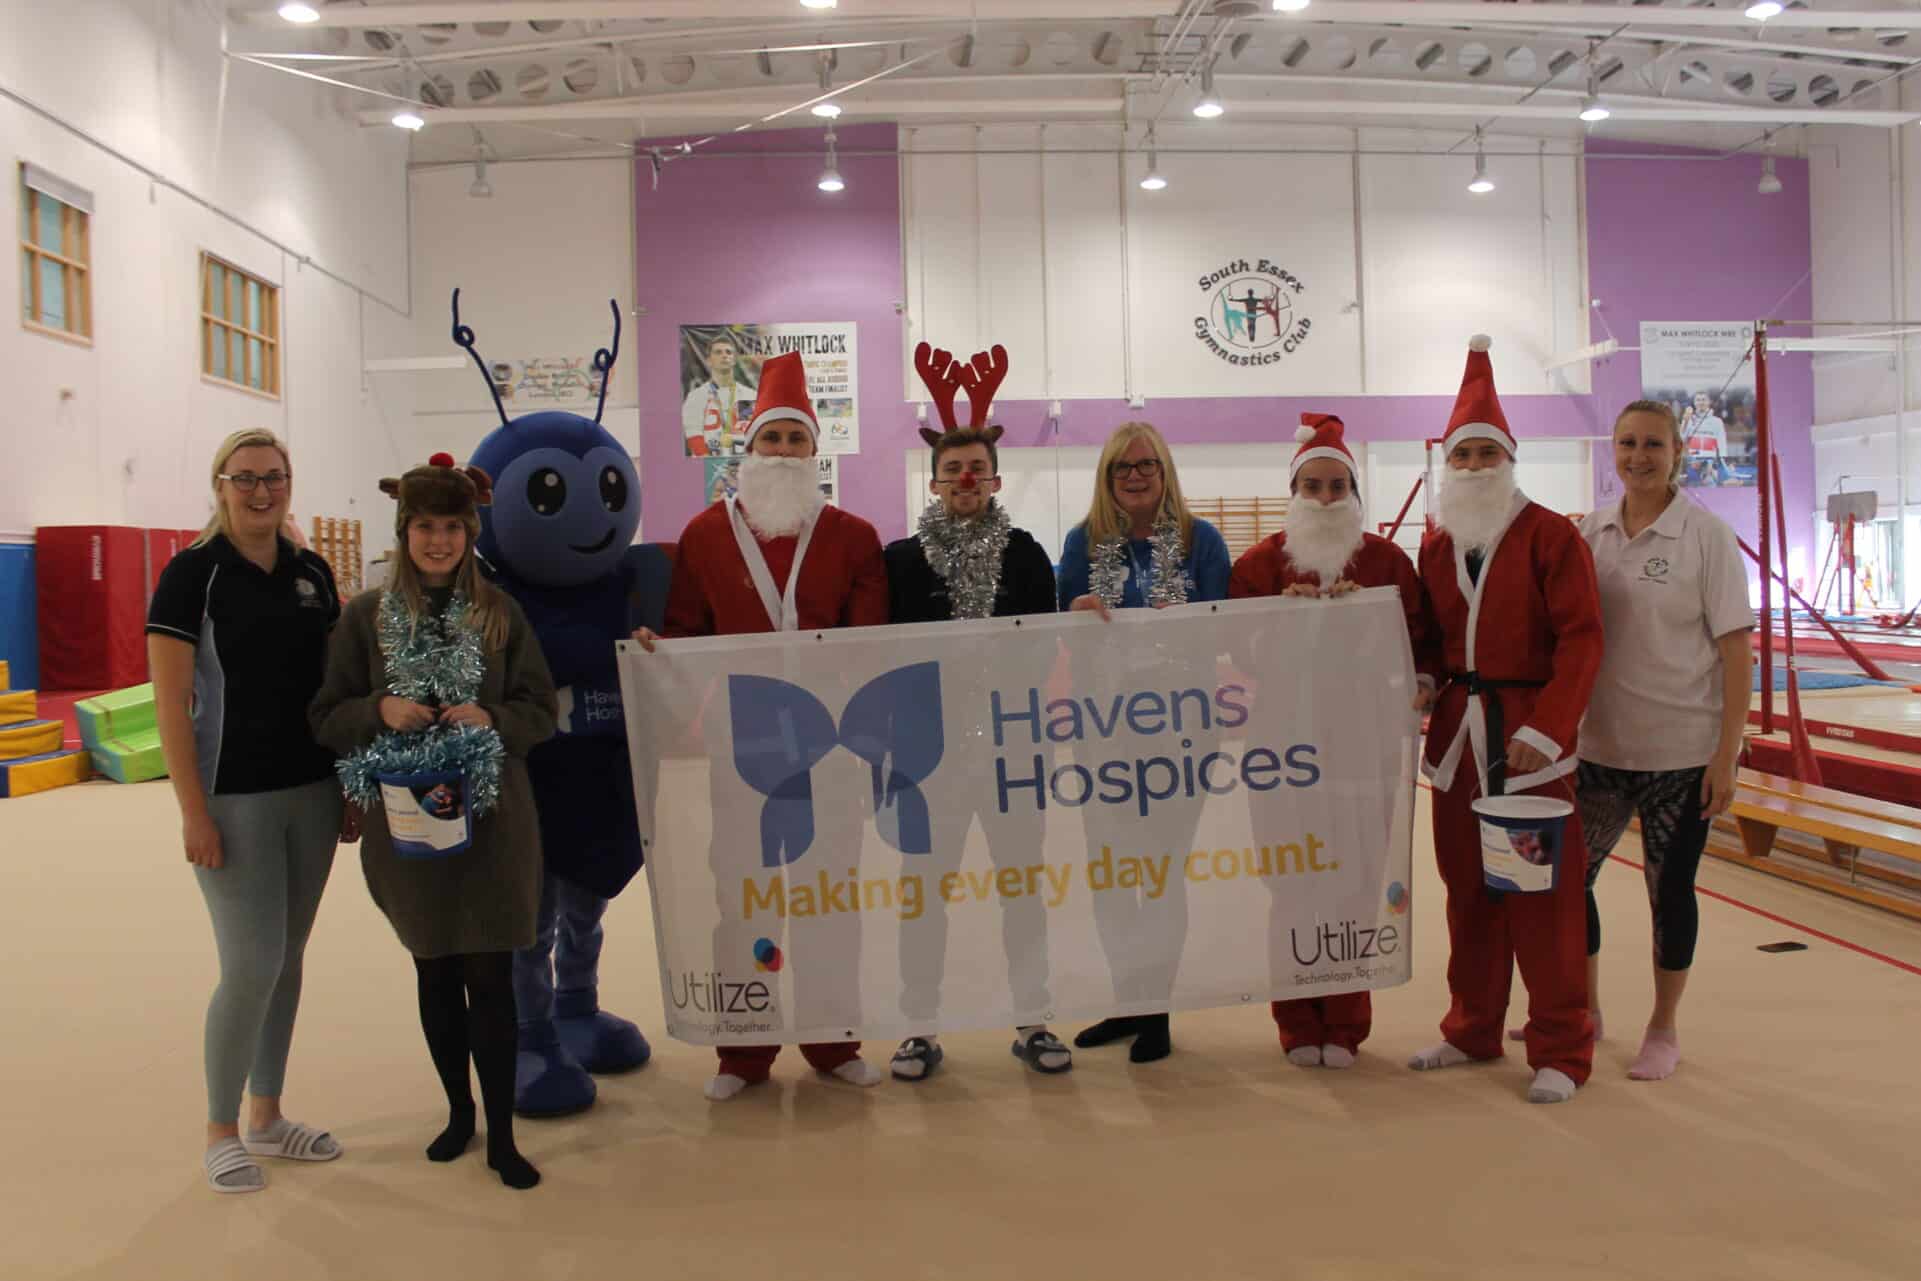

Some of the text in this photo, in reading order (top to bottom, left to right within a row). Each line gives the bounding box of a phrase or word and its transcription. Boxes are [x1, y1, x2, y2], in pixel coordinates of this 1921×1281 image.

[1198, 258, 1304, 294] South Essex
[778, 334, 847, 354] WHITLOCK
[1194, 316, 1311, 366] Gymnastics Club
[991, 684, 1249, 747] Havens
[995, 738, 1321, 817] Hospices
[741, 832, 1341, 921] Making every day count.
